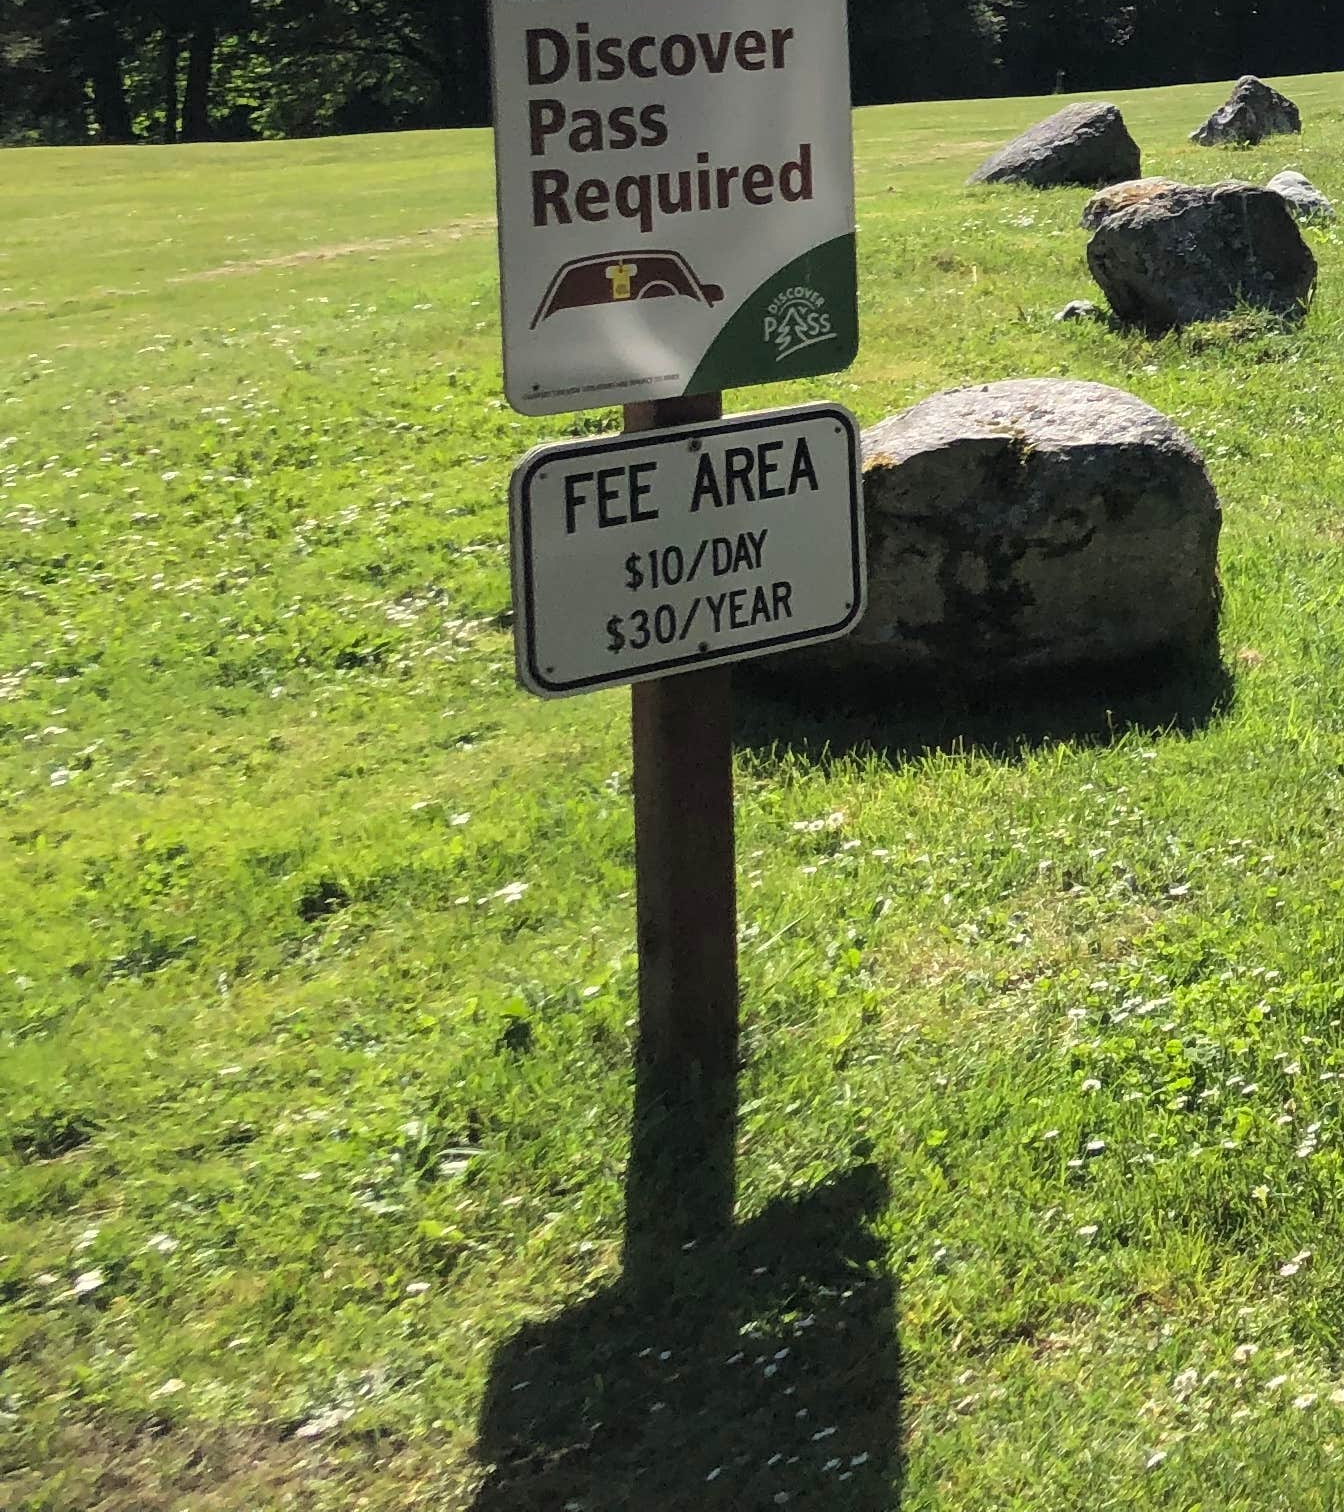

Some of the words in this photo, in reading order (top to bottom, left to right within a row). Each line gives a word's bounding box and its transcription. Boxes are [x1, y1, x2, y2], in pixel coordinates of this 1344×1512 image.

[525, 22, 793, 85] Discover
[528, 98, 669, 156] Pass
[531, 144, 815, 233] Required
[768, 286, 825, 314] DISCOVER
[564, 461, 659, 534] FEE
[690, 437, 819, 512] AREA
[625, 529, 768, 591] $10/DAY
[606, 581, 793, 654] $30/YEAR
